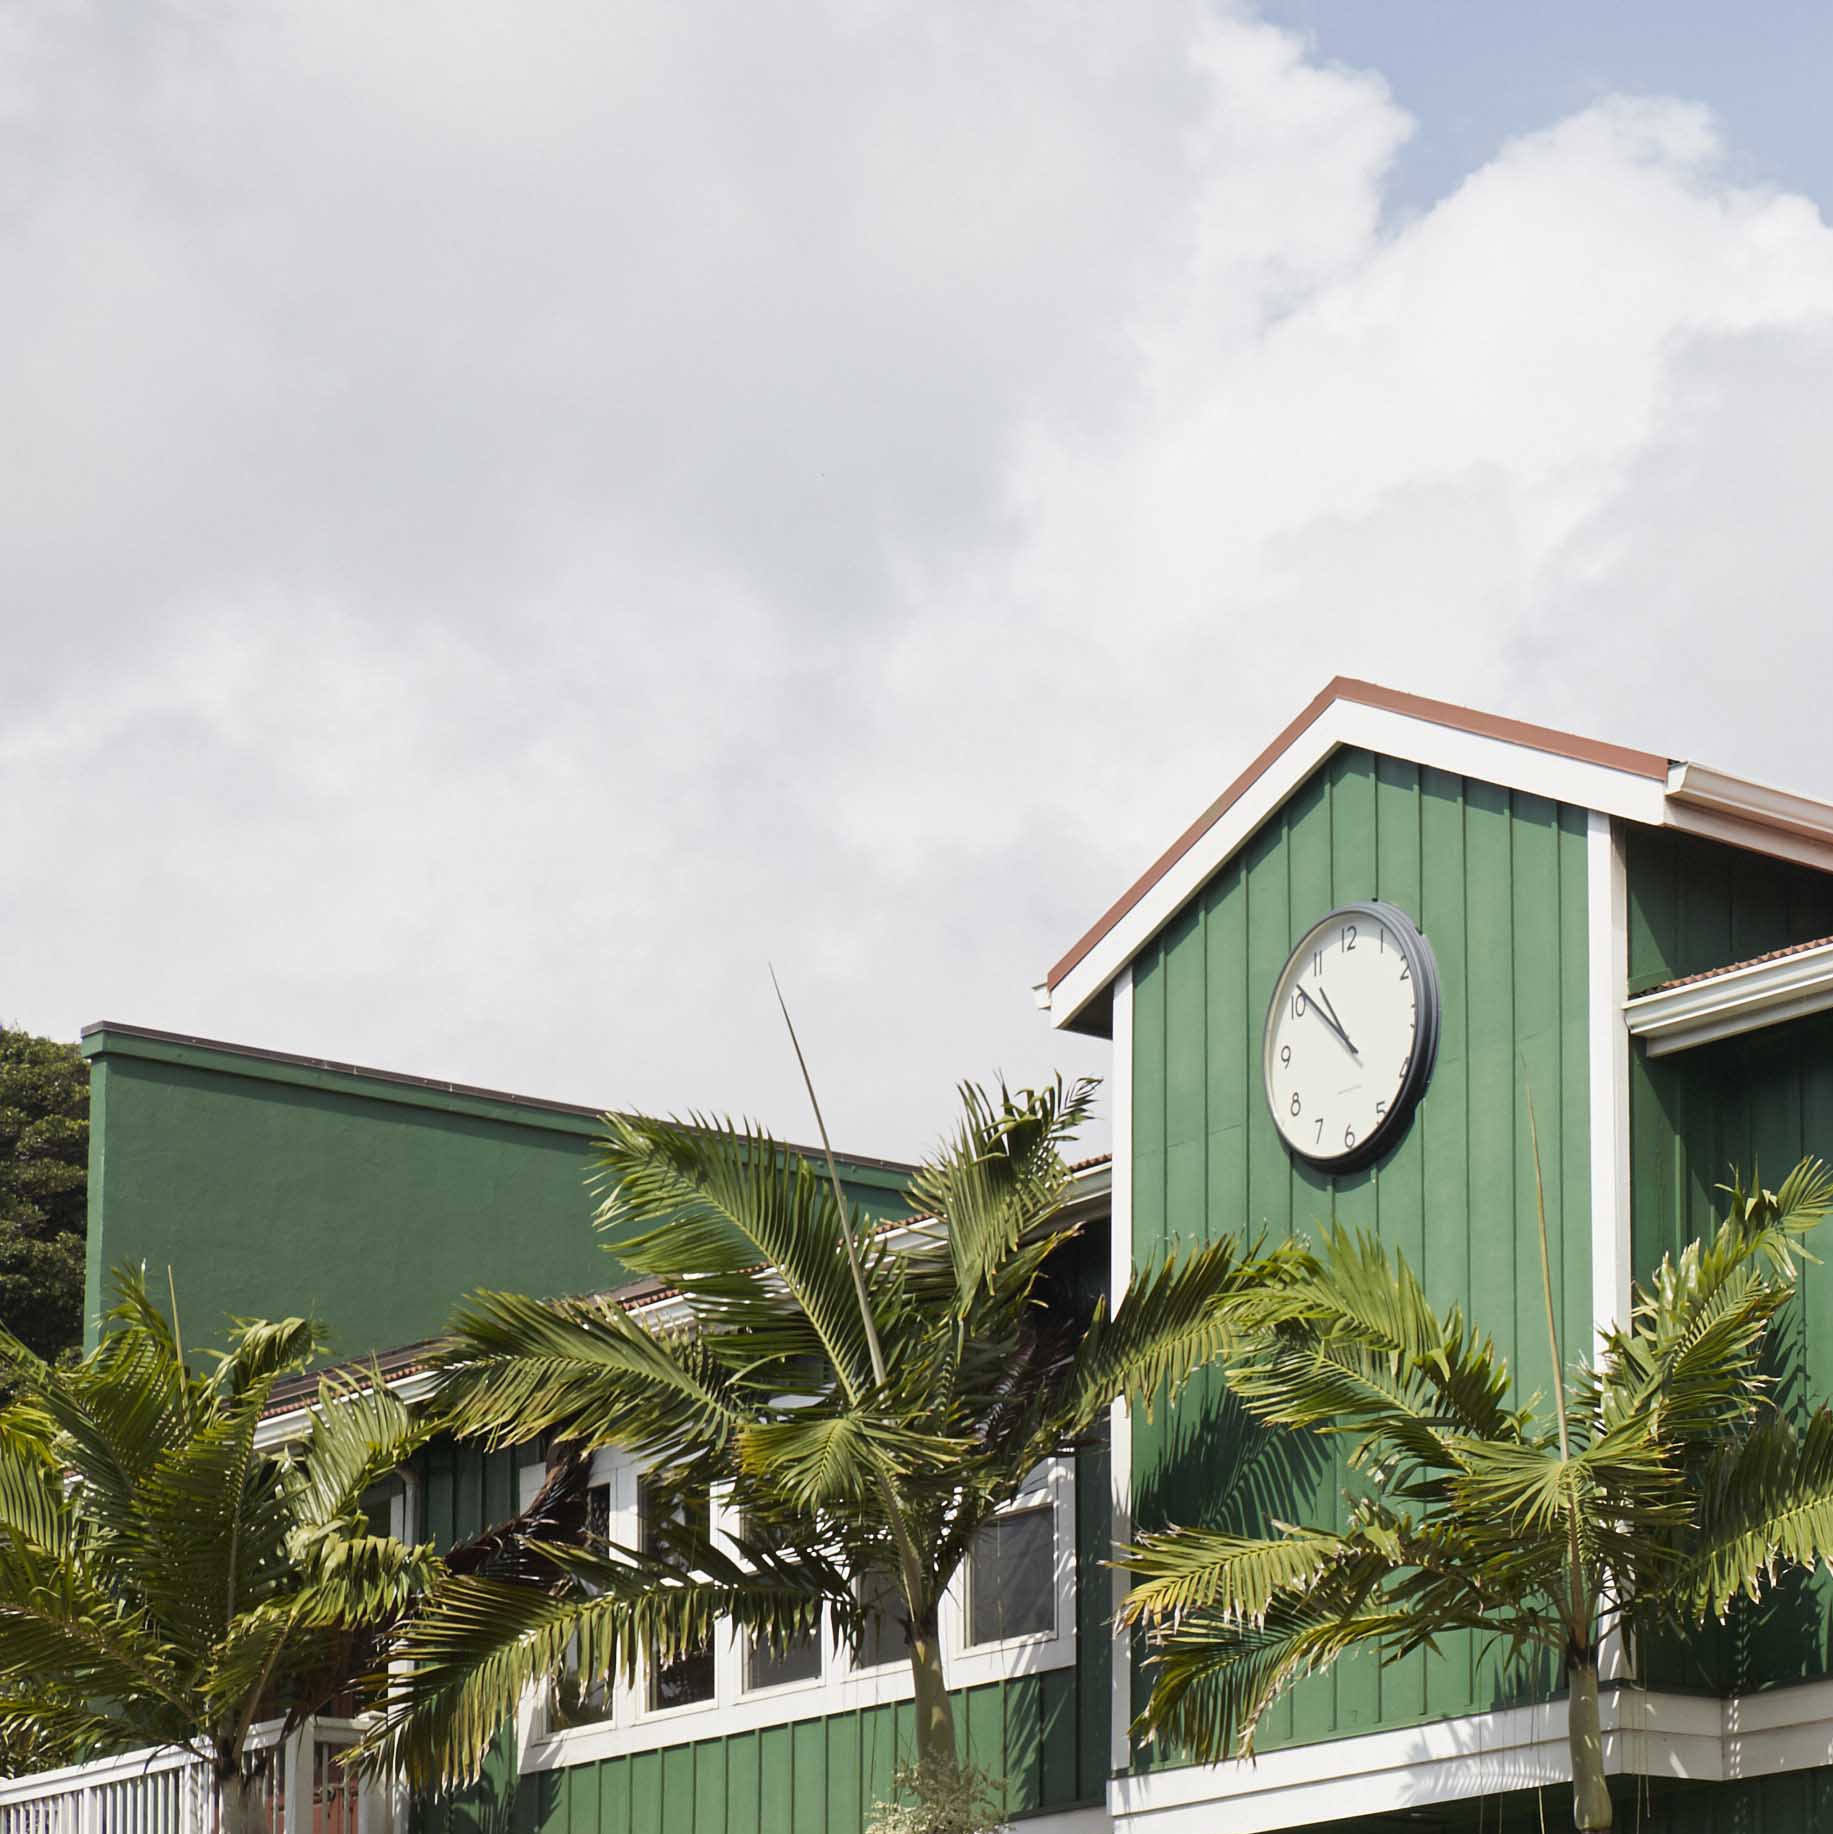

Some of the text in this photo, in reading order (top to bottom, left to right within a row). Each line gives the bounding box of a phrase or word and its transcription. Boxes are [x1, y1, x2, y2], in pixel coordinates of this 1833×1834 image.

[1341, 926, 1357, 953] 12
[1313, 951, 1323, 977] 11
[1400, 955, 1410, 980] 2
[1290, 991, 1307, 1020] 10
[1280, 1045, 1291, 1069] 9
[1290, 1092, 1301, 1117] 8
[1314, 1118, 1324, 1144] 7
[1344, 1124, 1355, 1149] 6
